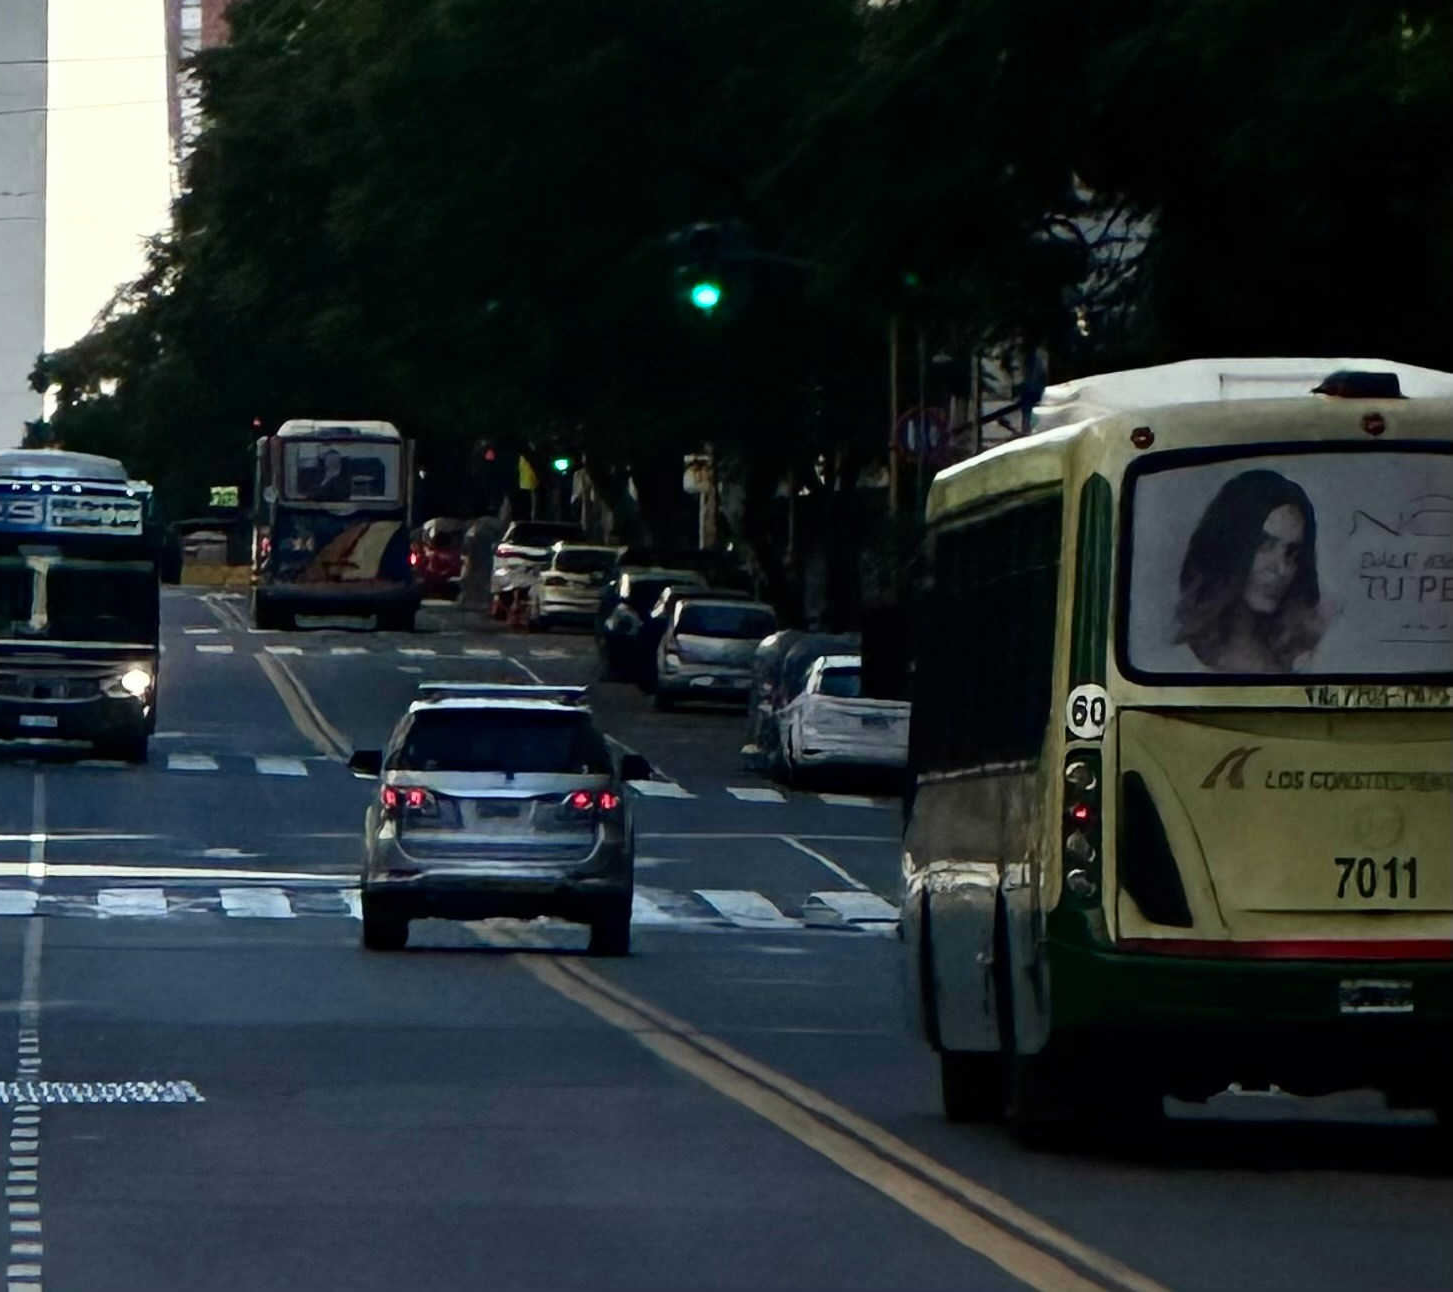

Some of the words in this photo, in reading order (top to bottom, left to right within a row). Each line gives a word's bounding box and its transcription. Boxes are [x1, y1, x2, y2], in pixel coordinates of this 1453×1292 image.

[1072, 695, 1107, 727] 60
[1265, 771, 1305, 790] LOS
[1334, 856, 1418, 899] 7011
